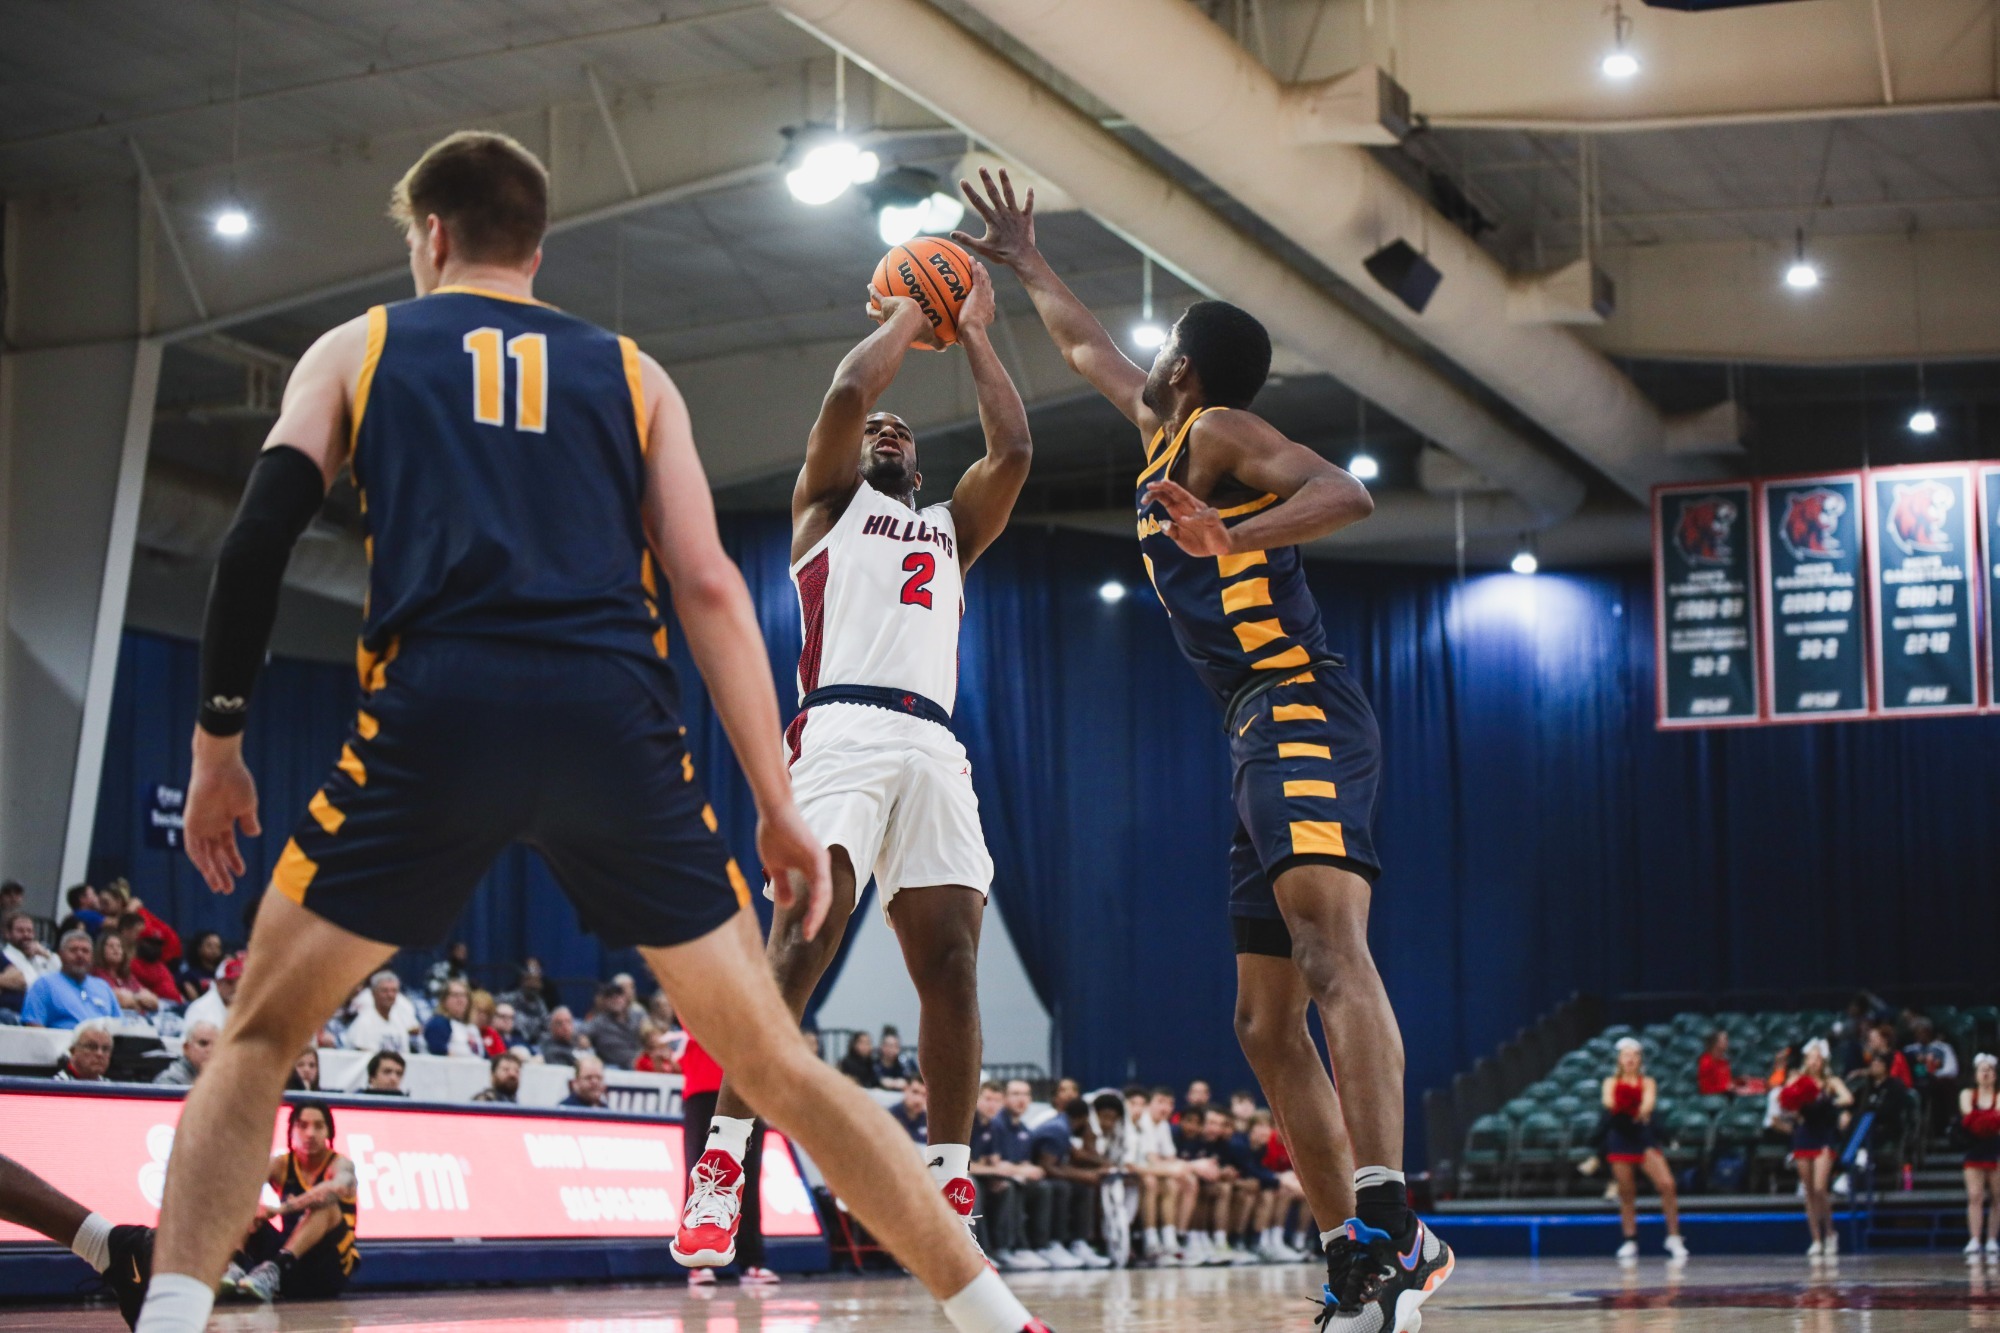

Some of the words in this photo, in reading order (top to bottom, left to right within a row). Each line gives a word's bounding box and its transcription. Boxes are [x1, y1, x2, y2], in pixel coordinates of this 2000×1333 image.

[929, 253, 967, 302] NCAA
[463, 327, 548, 434] 11
[900, 552, 935, 610] 2
[347, 1134, 469, 1211] Farm
